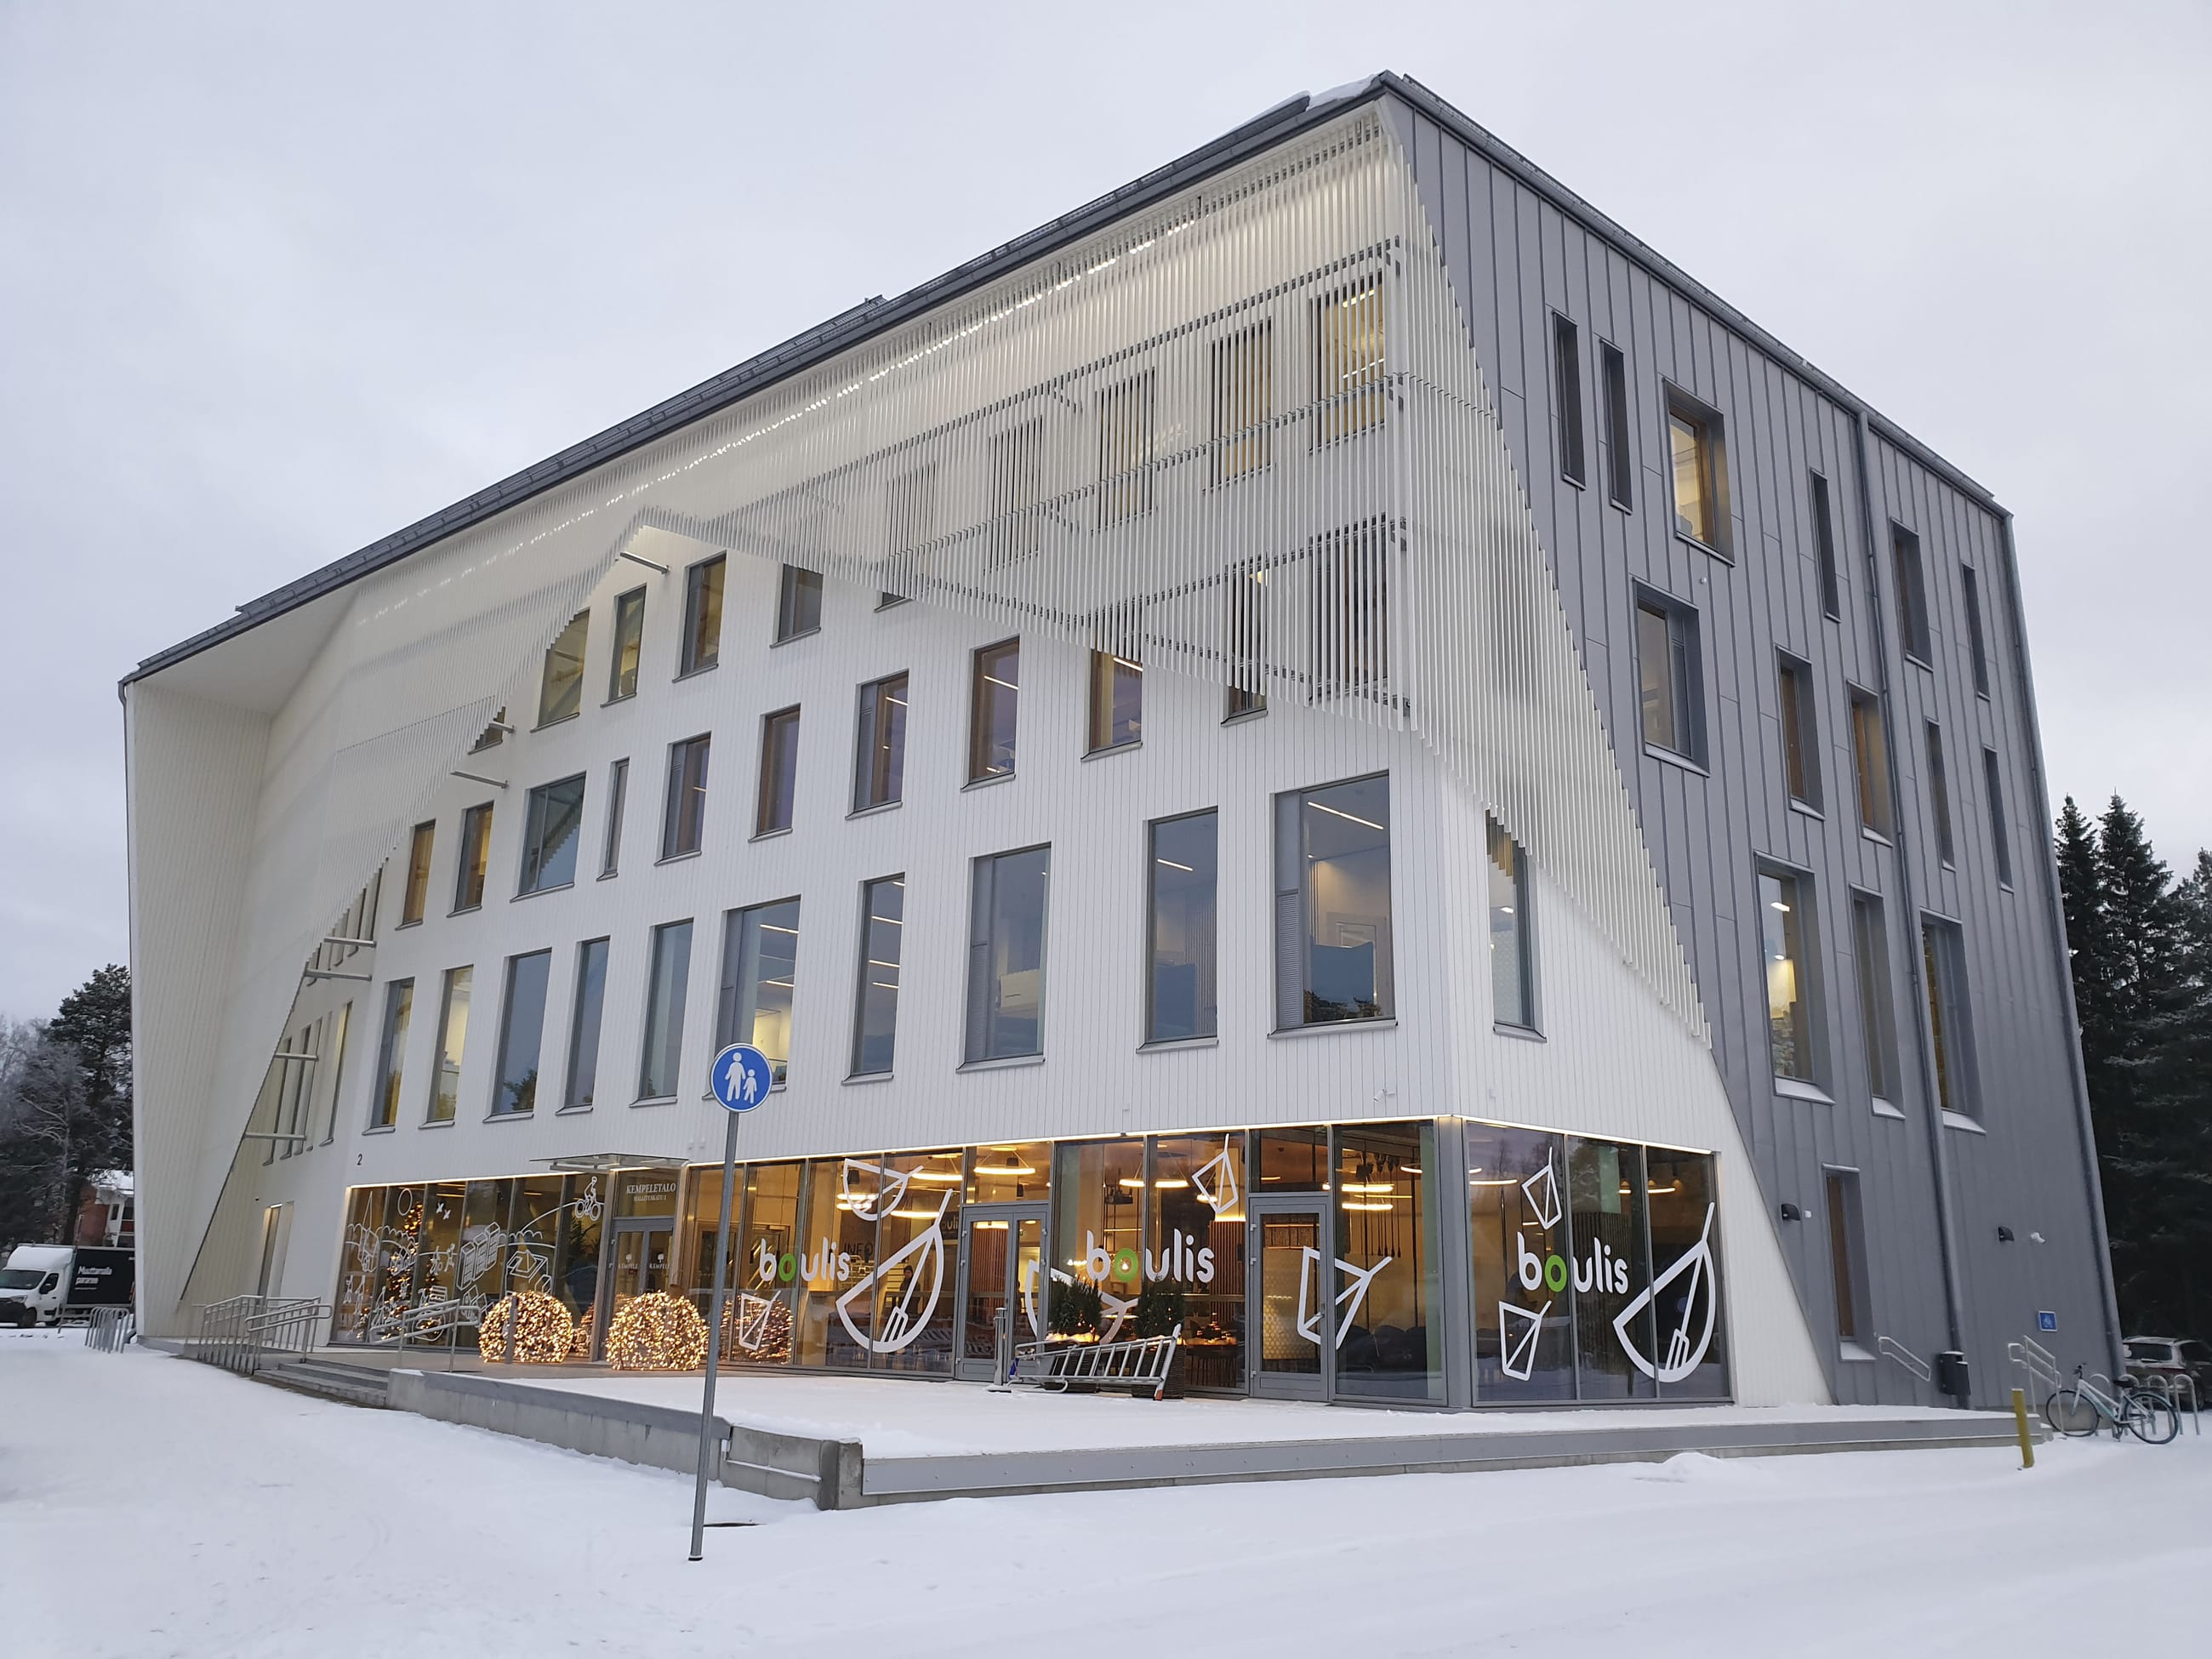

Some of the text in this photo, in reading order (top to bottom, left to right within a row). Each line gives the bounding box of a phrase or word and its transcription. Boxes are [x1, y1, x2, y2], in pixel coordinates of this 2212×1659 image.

[357, 1153, 362, 1166] 2
[626, 1183, 676, 1194] KEMPELETALO
[760, 1236, 850, 1282] boulis
[1086, 1228, 1215, 1283] boulis
[1517, 1231, 1628, 1294] boulis
